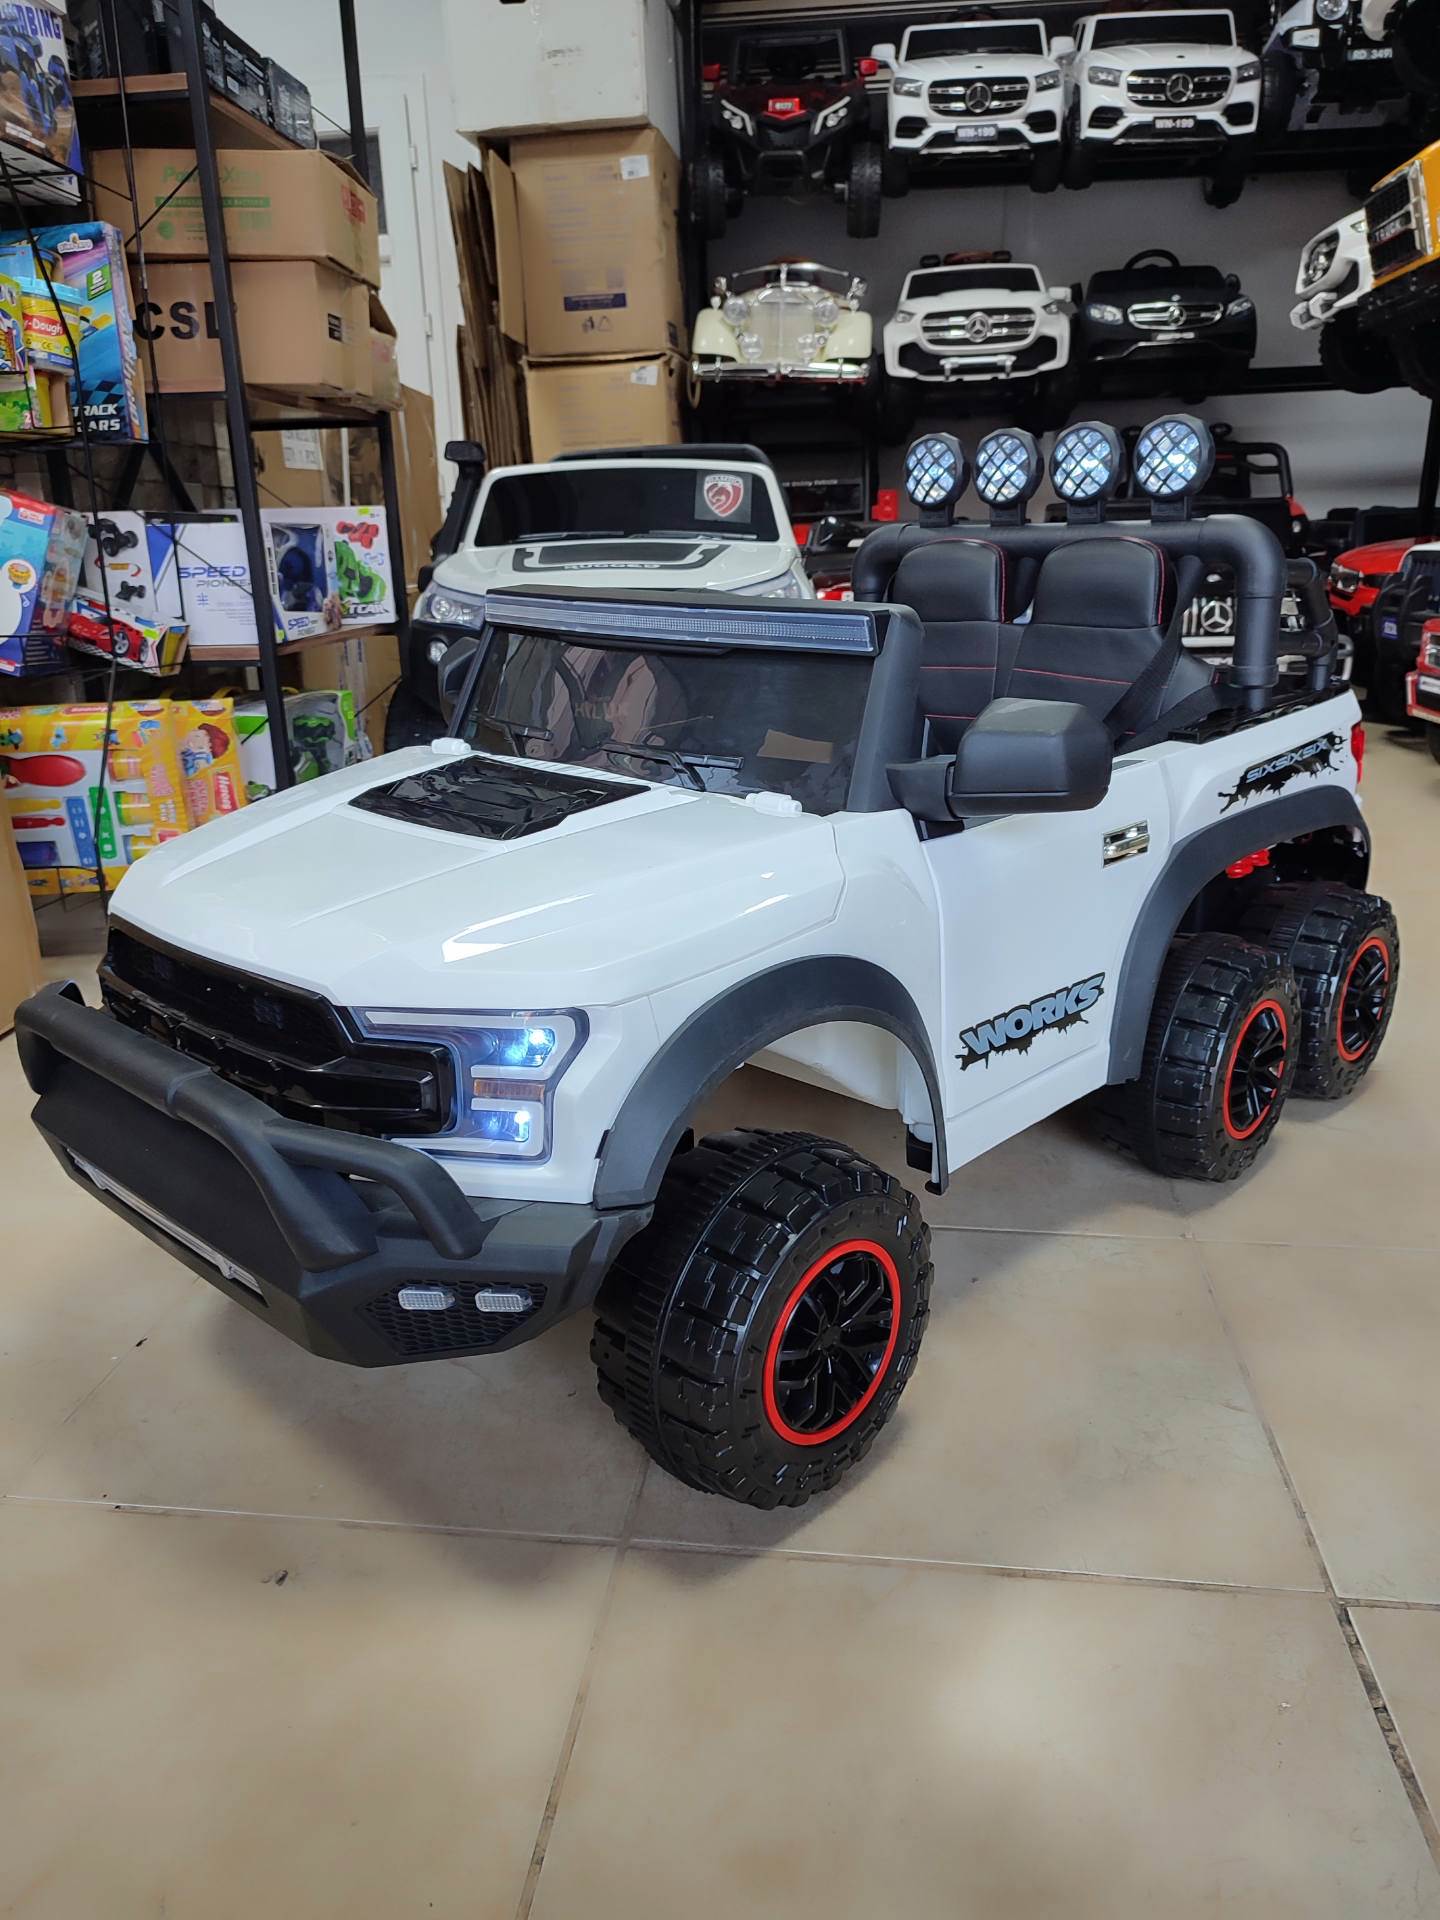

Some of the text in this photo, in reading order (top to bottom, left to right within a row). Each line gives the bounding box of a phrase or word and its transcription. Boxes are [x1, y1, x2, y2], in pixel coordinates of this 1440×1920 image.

[72, 404, 118, 416] TRACK
[178, 566, 246, 578] SPEED
[961, 975, 1104, 1055] WORKS
